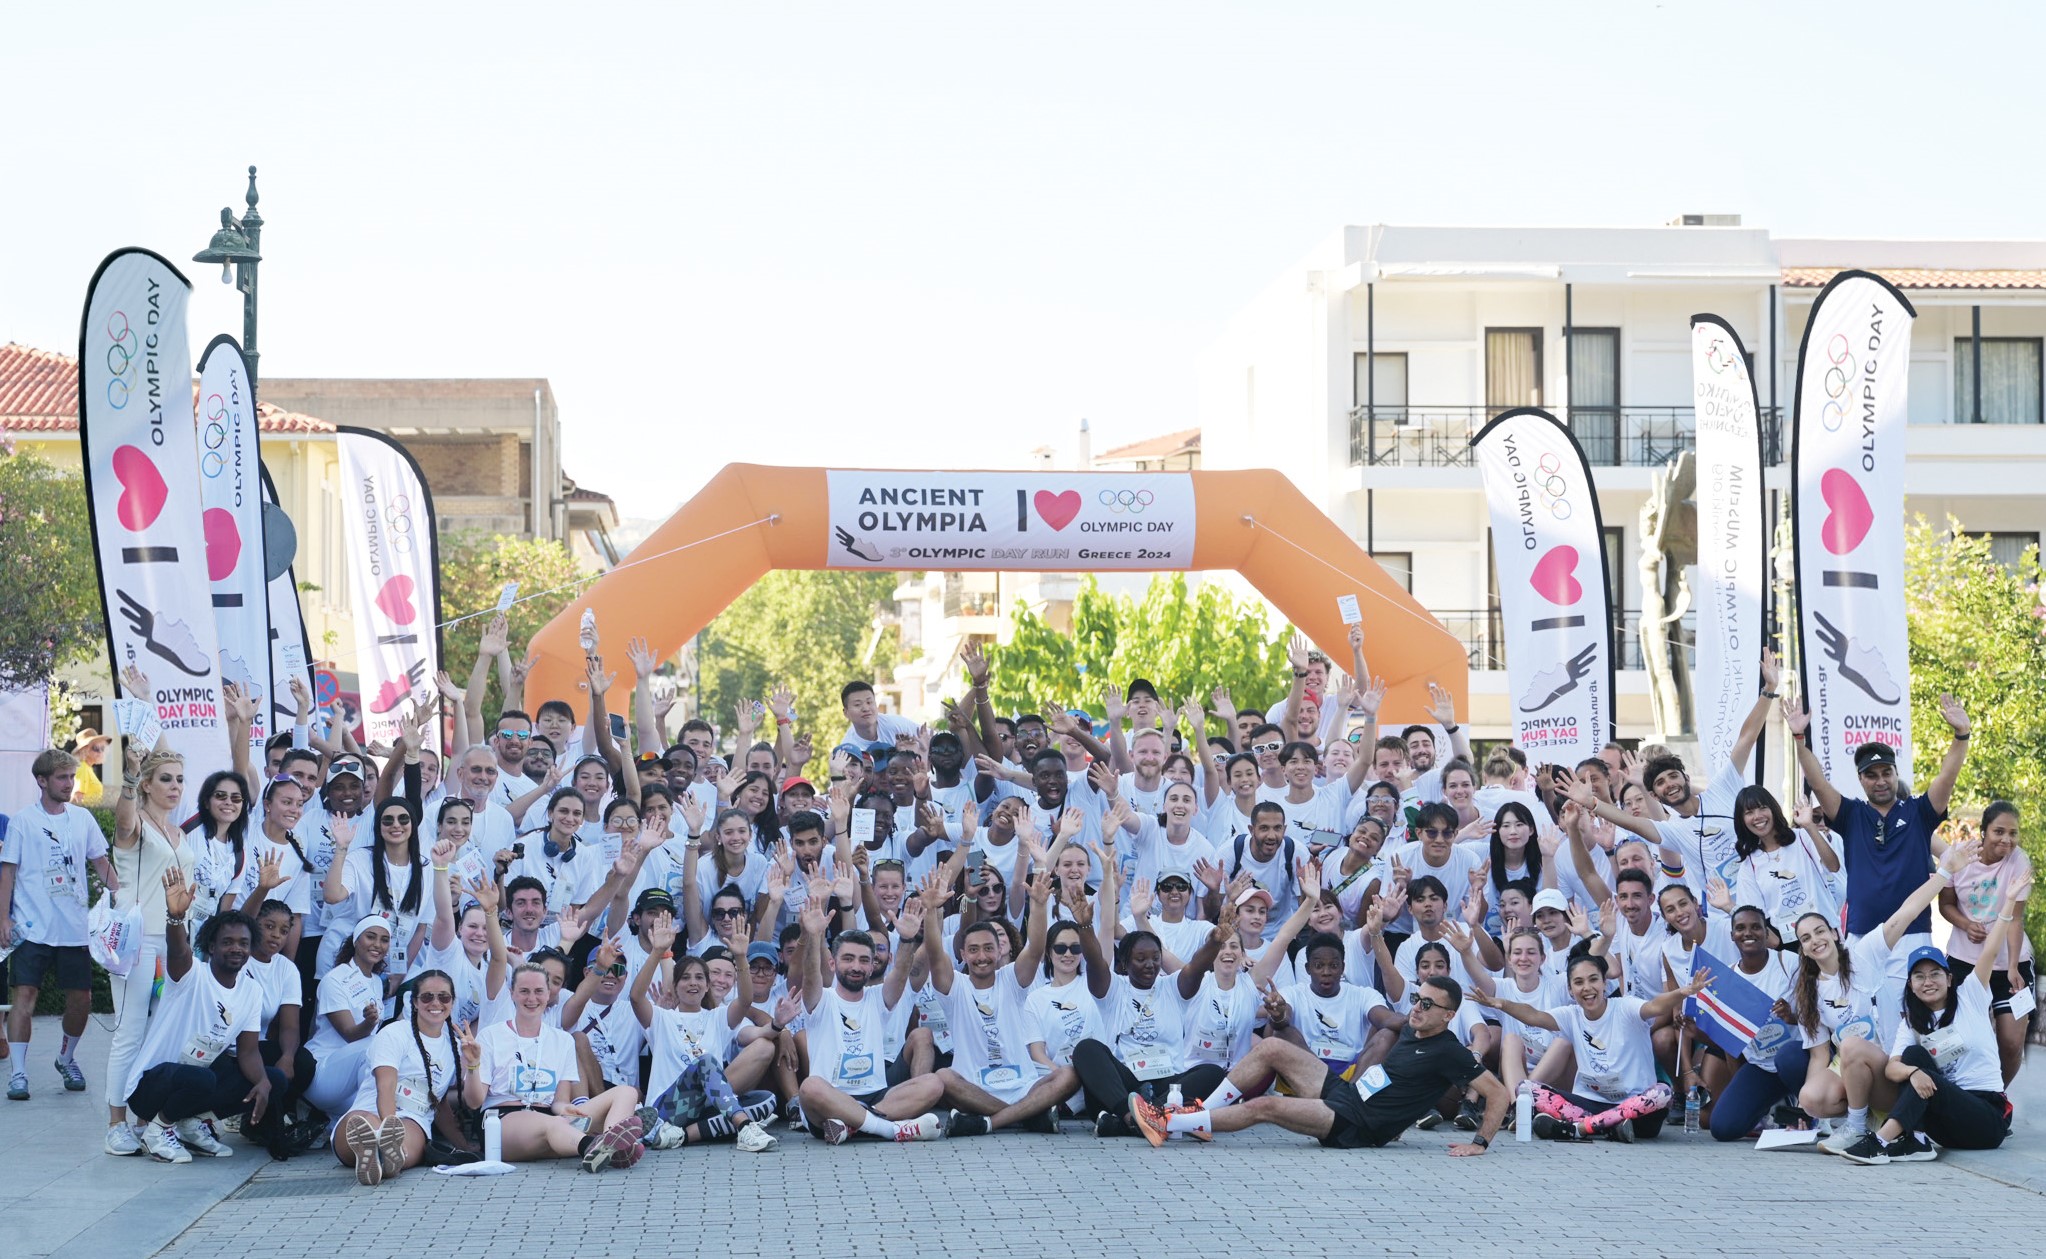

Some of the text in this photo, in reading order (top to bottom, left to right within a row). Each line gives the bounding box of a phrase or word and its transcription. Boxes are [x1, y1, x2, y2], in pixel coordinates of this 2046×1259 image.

[146, 277, 164, 446] OLYMPIC DAY
[1862, 303, 1884, 472] OLYMPIC DAY
[230, 367, 242, 508] OLYMPIC DAY
[858, 488, 984, 507] ANCIENT
[1017, 489, 1028, 532] I
[858, 511, 987, 532] OLYMPIA
[1080, 522, 1174, 533] OLYMPIC DAY
[908, 548, 986, 559] OLYMPIC
[991, 548, 1029, 559] DAY
[1031, 548, 1069, 559] RUN
[1137, 548, 1171, 559] 2024
[156, 687, 214, 704] OLYMPIC
[158, 703, 217, 720] DAY RUN
[160, 718, 218, 730] GREECE
[1844, 715, 1902, 732] OLYMPIC
[1845, 731, 1902, 747] DAY RUN
